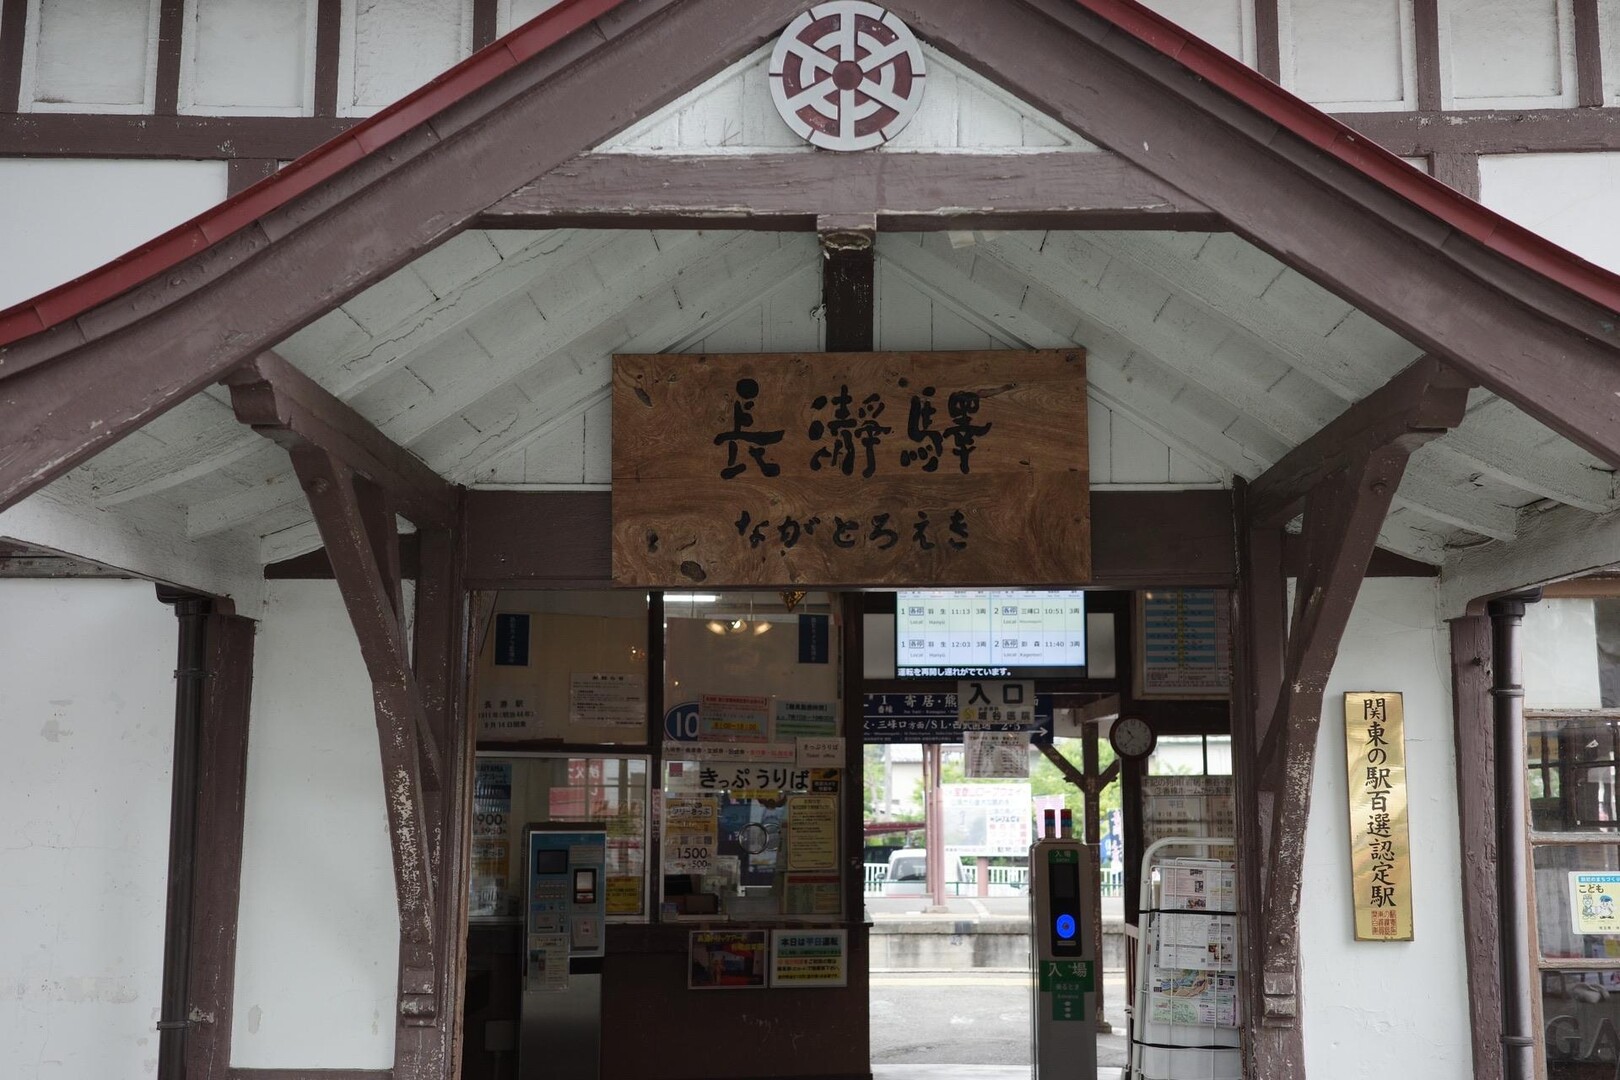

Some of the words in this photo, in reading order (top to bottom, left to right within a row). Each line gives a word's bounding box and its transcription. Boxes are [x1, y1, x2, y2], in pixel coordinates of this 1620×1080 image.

[735, 510, 968, 551] ながとろえき
[969, 683, 1023, 704] 入口
[700, 768, 809, 789] きっぷうりば
[1363, 698, 1397, 907] 関東の駅百選認定駅
[1579, 884, 1604, 893] こども
[1048, 962, 1087, 978] 入場
